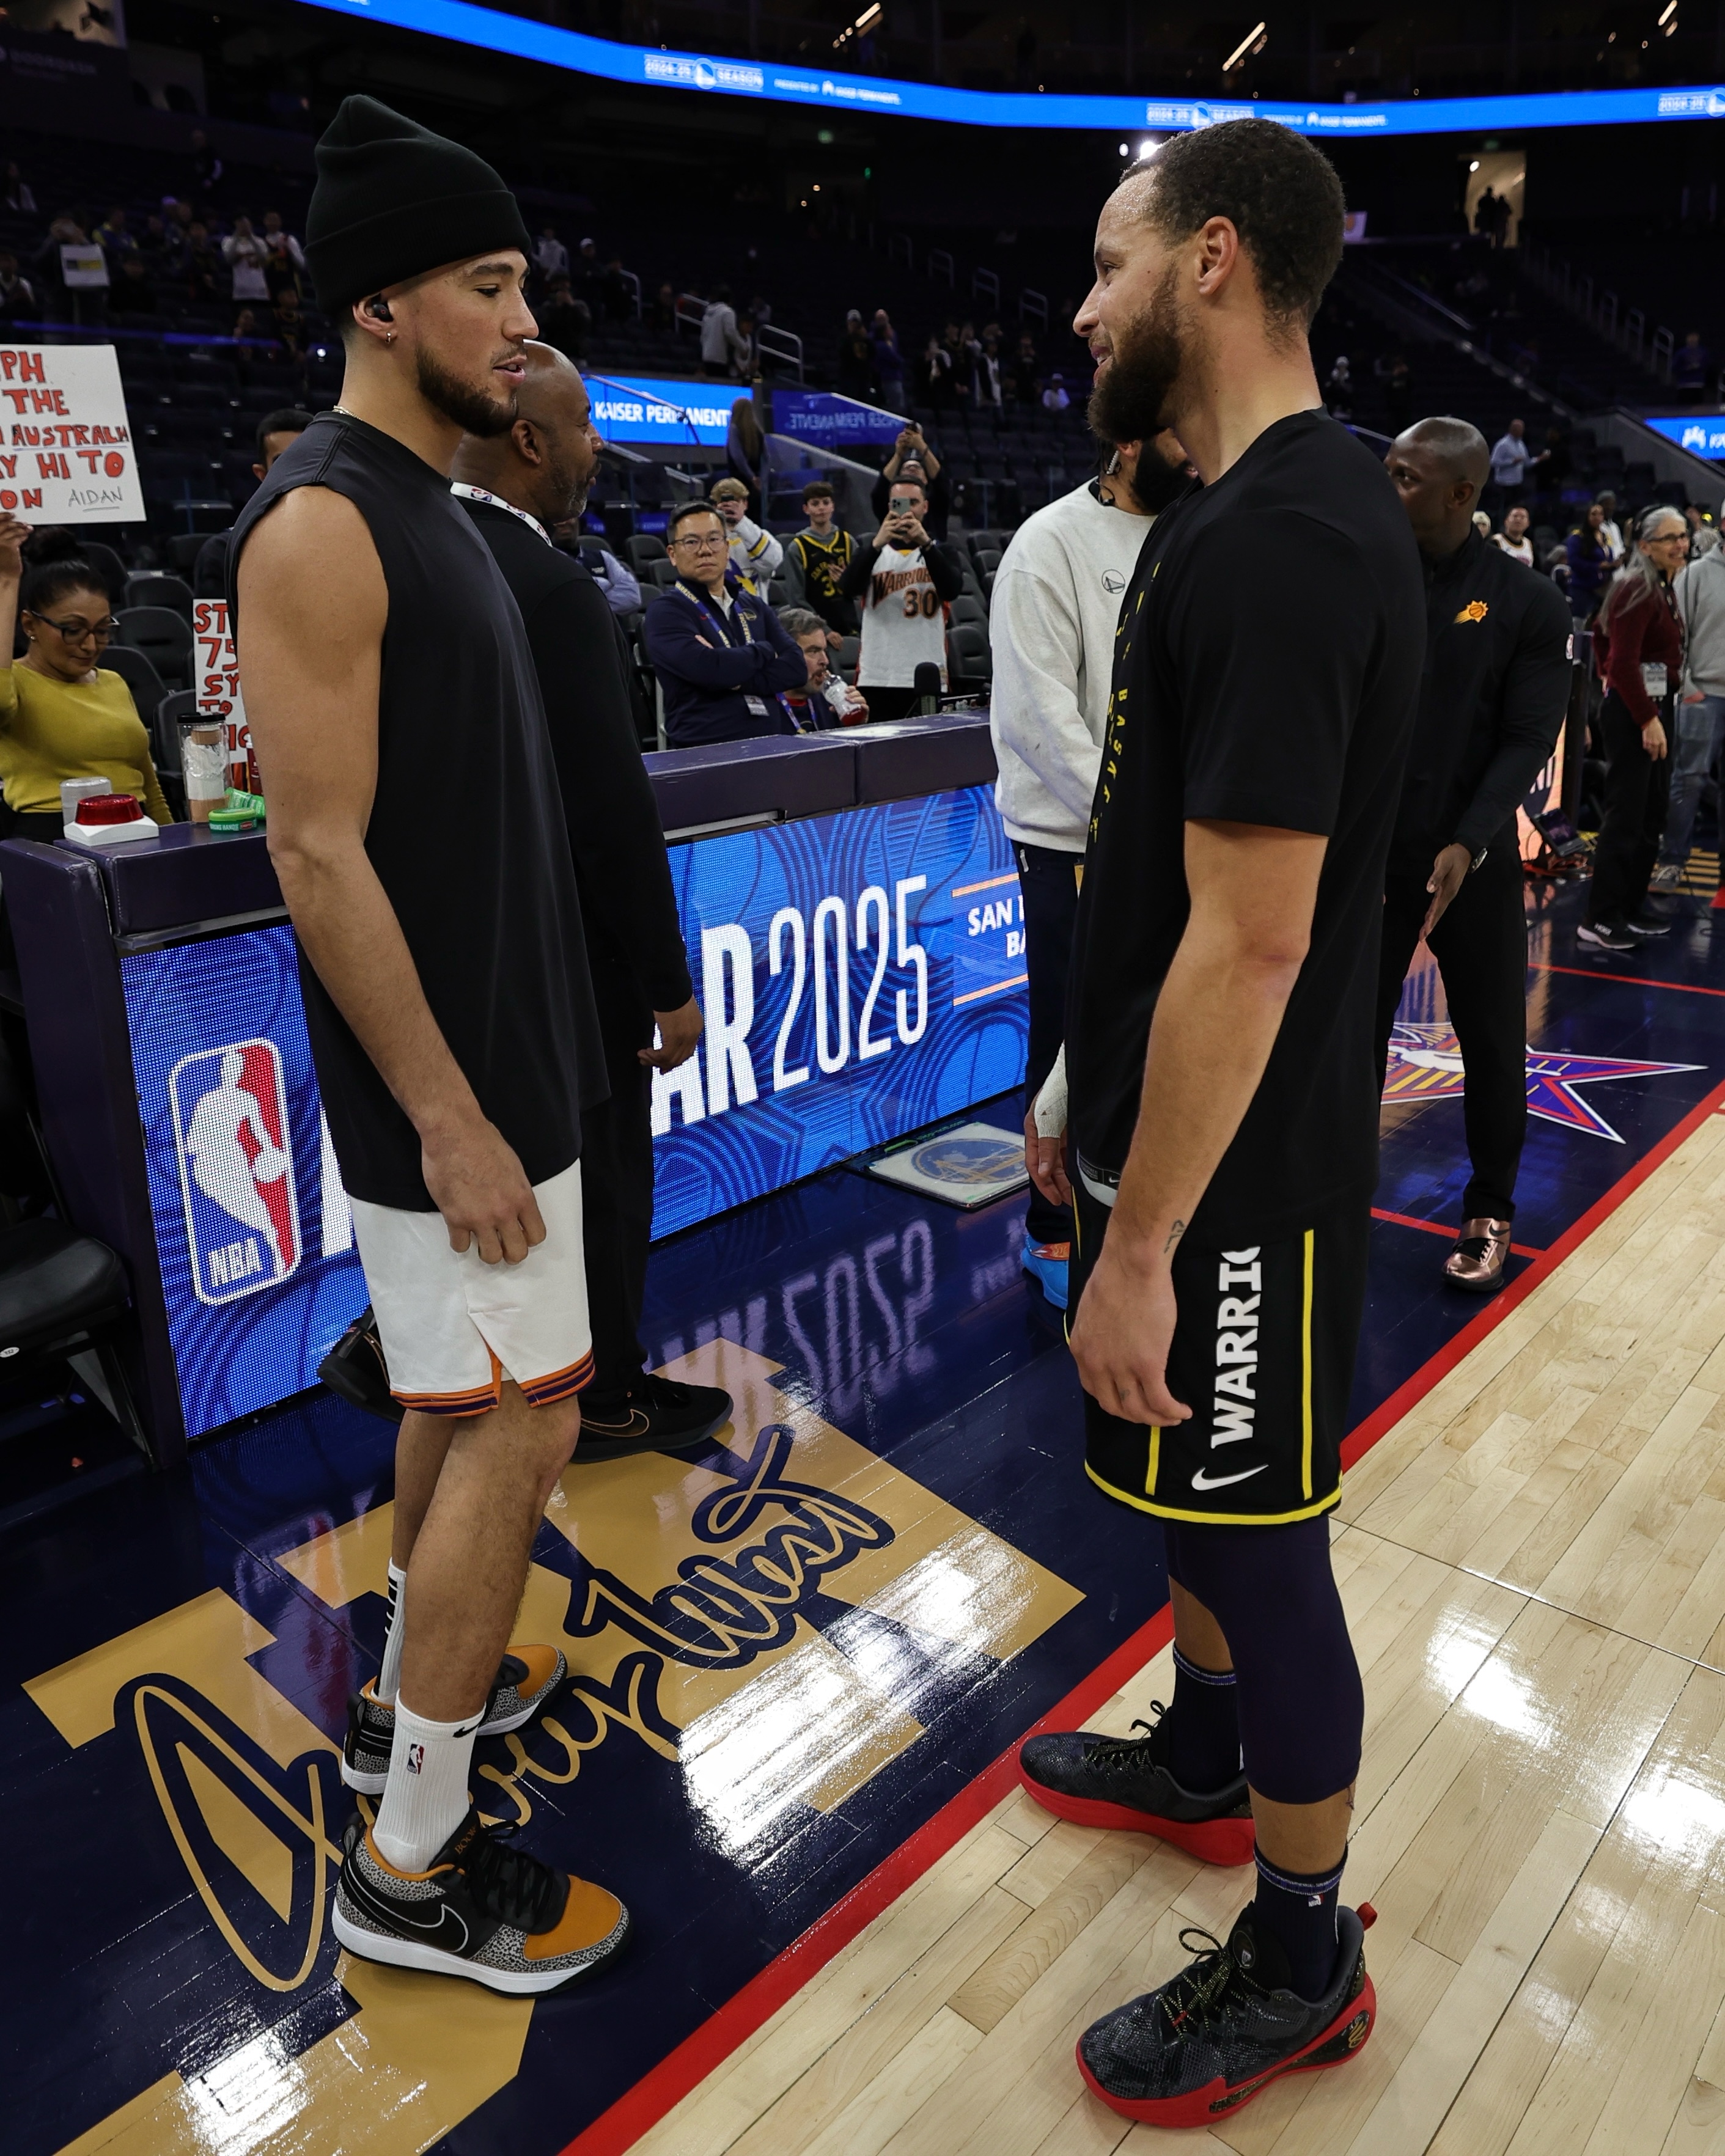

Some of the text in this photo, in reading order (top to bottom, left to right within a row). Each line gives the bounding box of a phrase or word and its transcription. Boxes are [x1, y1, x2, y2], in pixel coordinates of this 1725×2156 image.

[0, 351, 46, 383] PH
[2, 388, 70, 416] THE
[595, 400, 643, 422] KAISER
[35, 452, 71, 480] HI
[76, 450, 125, 478] TO
[68, 486, 122, 508] AIDAN
[903, 588, 941, 620] 30
[968, 898, 1012, 936] SAN
[769, 875, 928, 1092] 2025
[208, 1237, 263, 1288] NBA
[580, 1431, 879, 1657] West
